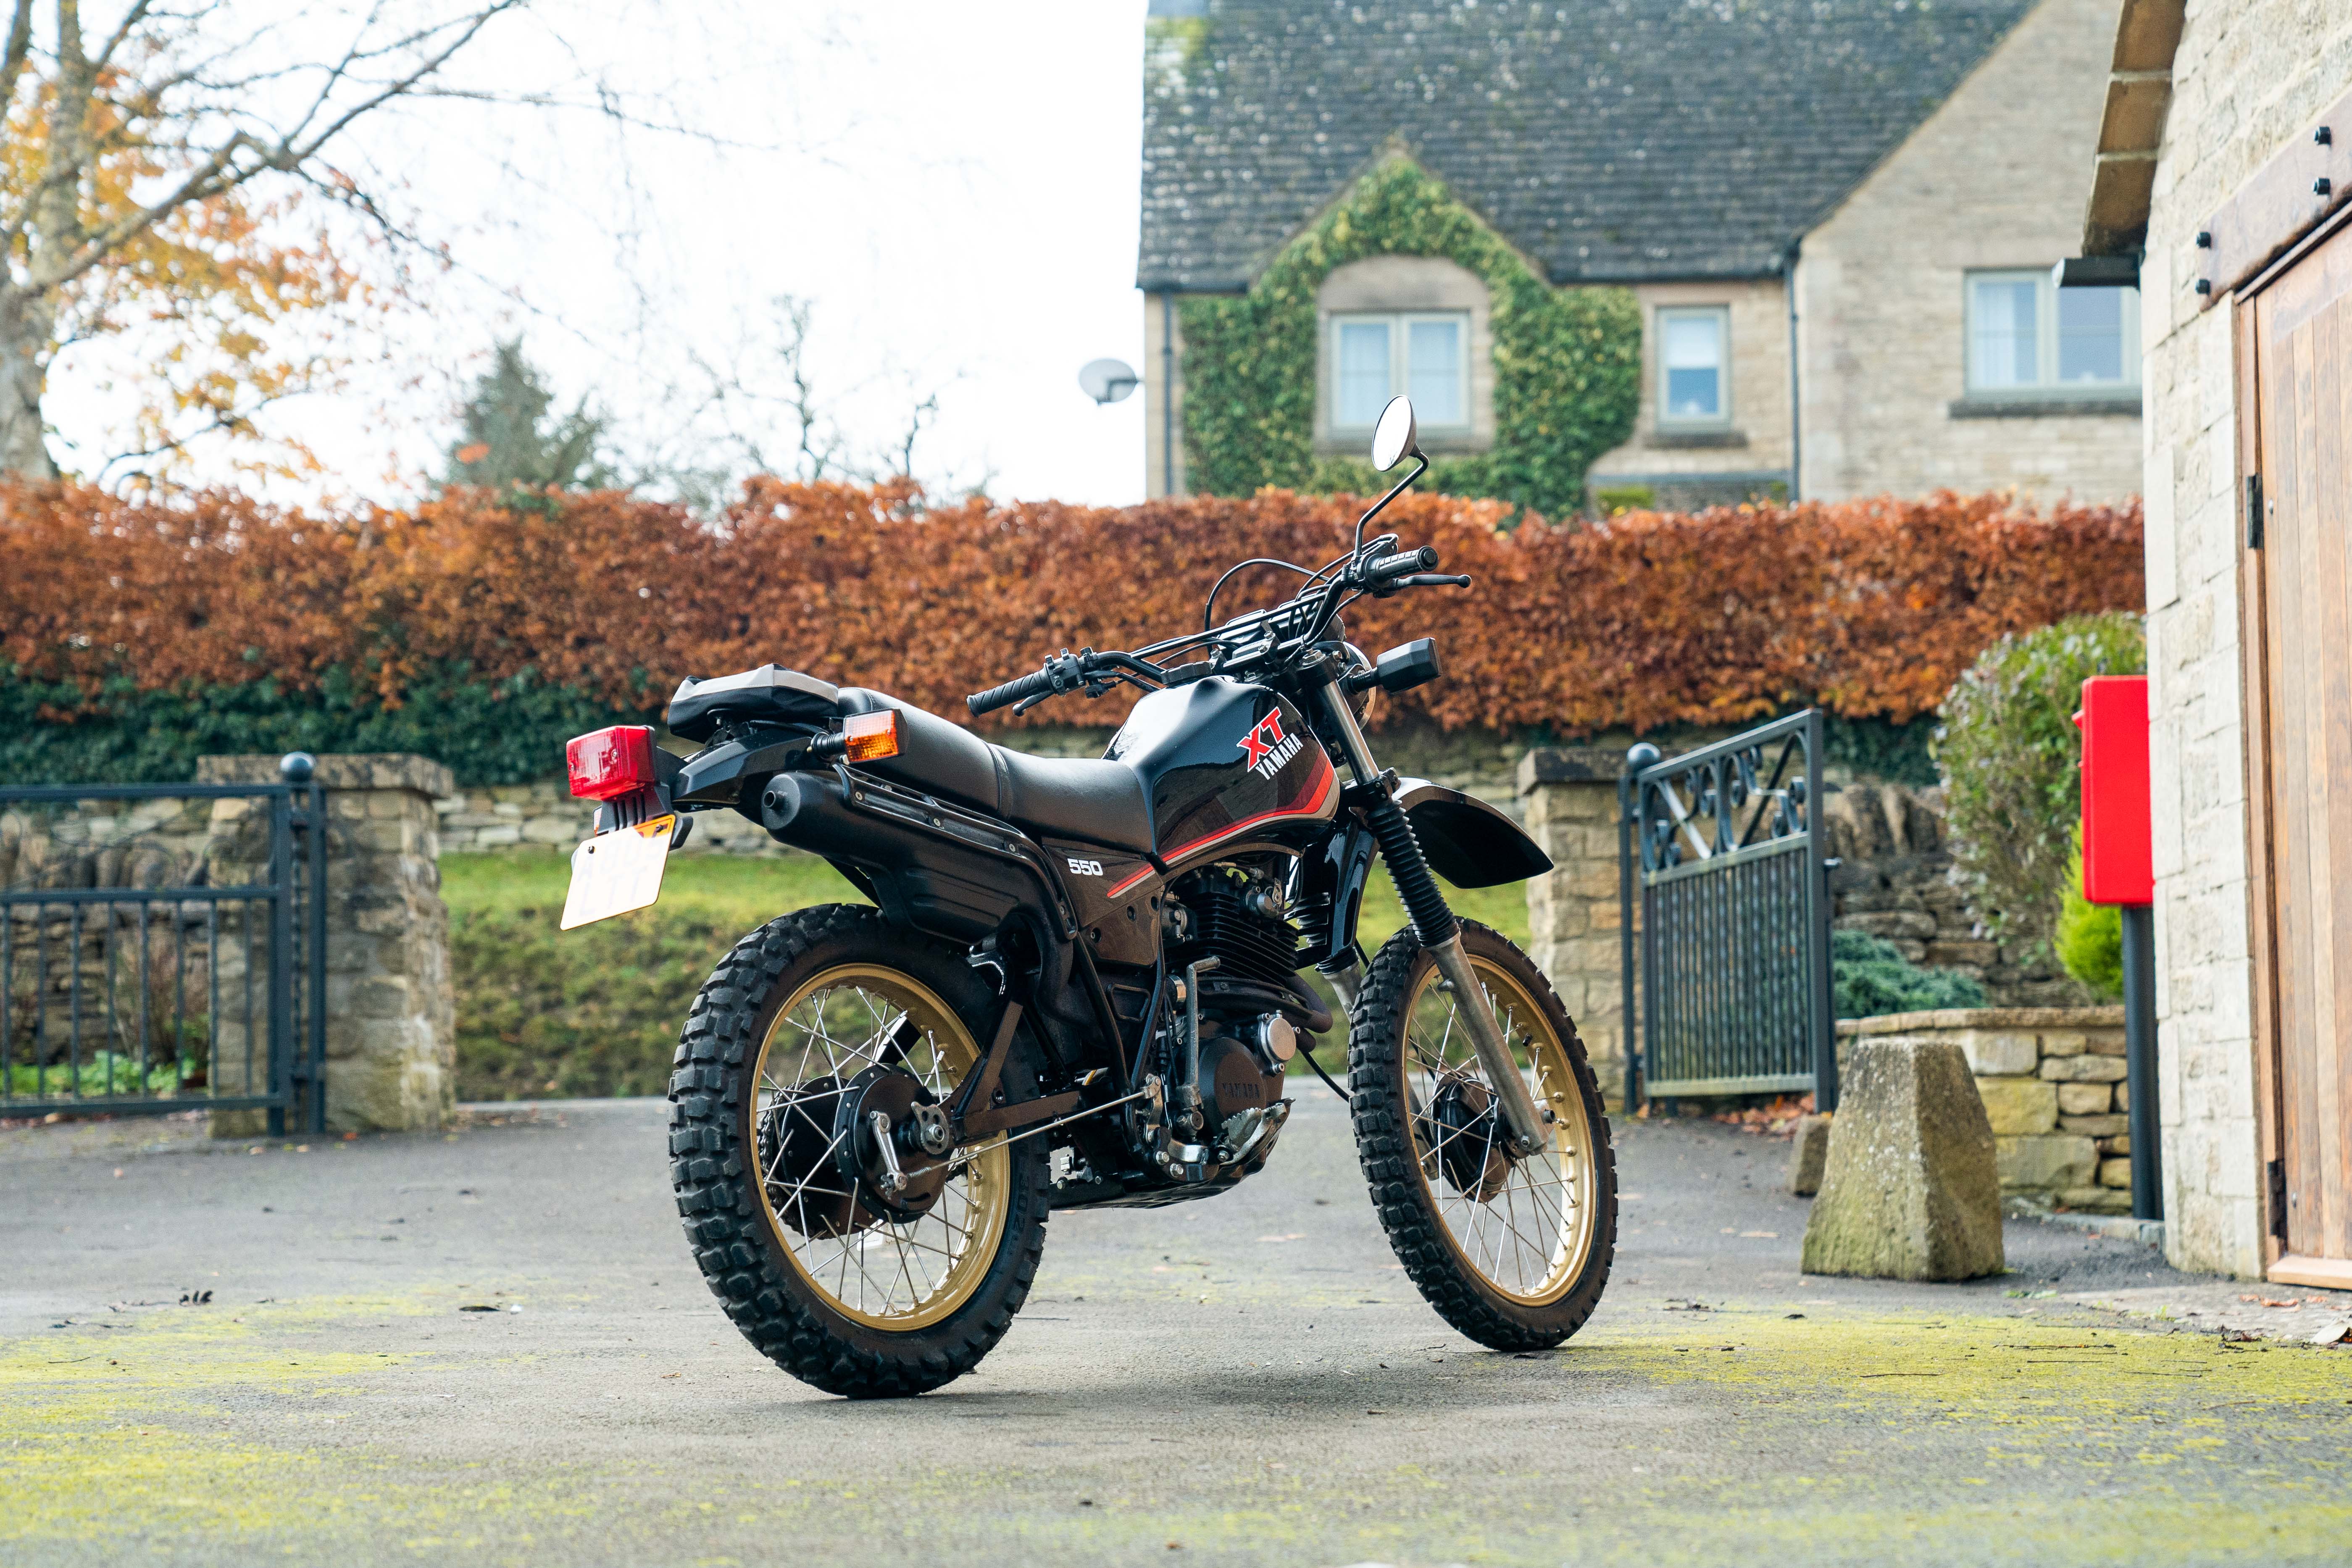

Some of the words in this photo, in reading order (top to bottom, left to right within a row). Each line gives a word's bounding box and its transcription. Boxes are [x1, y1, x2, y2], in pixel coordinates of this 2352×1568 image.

[1237, 706, 1286, 772] XT
[1255, 733, 1303, 780] YAMAHA
[1067, 858, 1103, 876] 550
